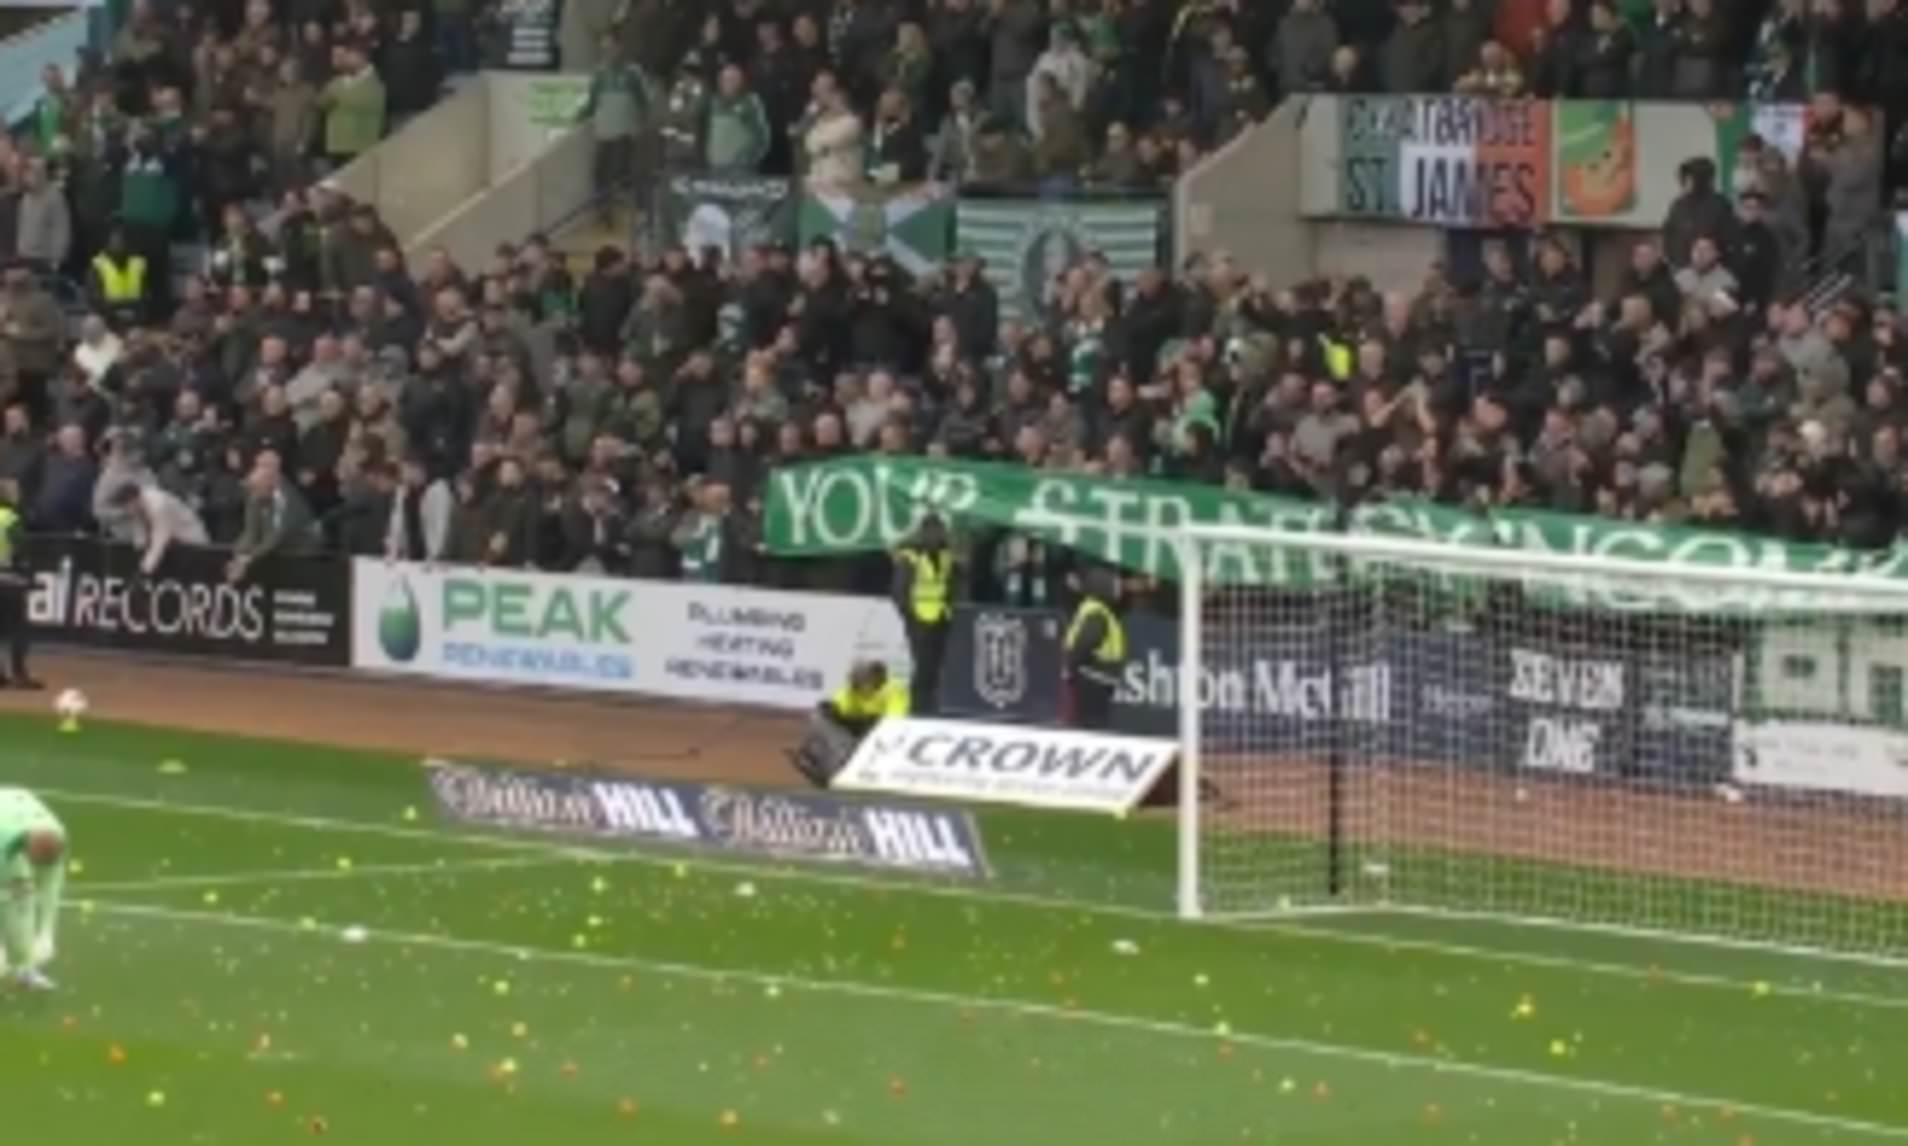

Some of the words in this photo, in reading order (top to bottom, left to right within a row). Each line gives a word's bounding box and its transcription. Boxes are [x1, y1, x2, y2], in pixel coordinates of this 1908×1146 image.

[1412, 156, 1536, 223] JAMES
[74, 573, 264, 642] RECORDS
[442, 577, 633, 645] PEAK
[1509, 648, 1624, 709] SEVEN
[907, 734, 1155, 782] CROWN
[593, 779, 698, 837] HILL
[863, 806, 970, 868] HILL
